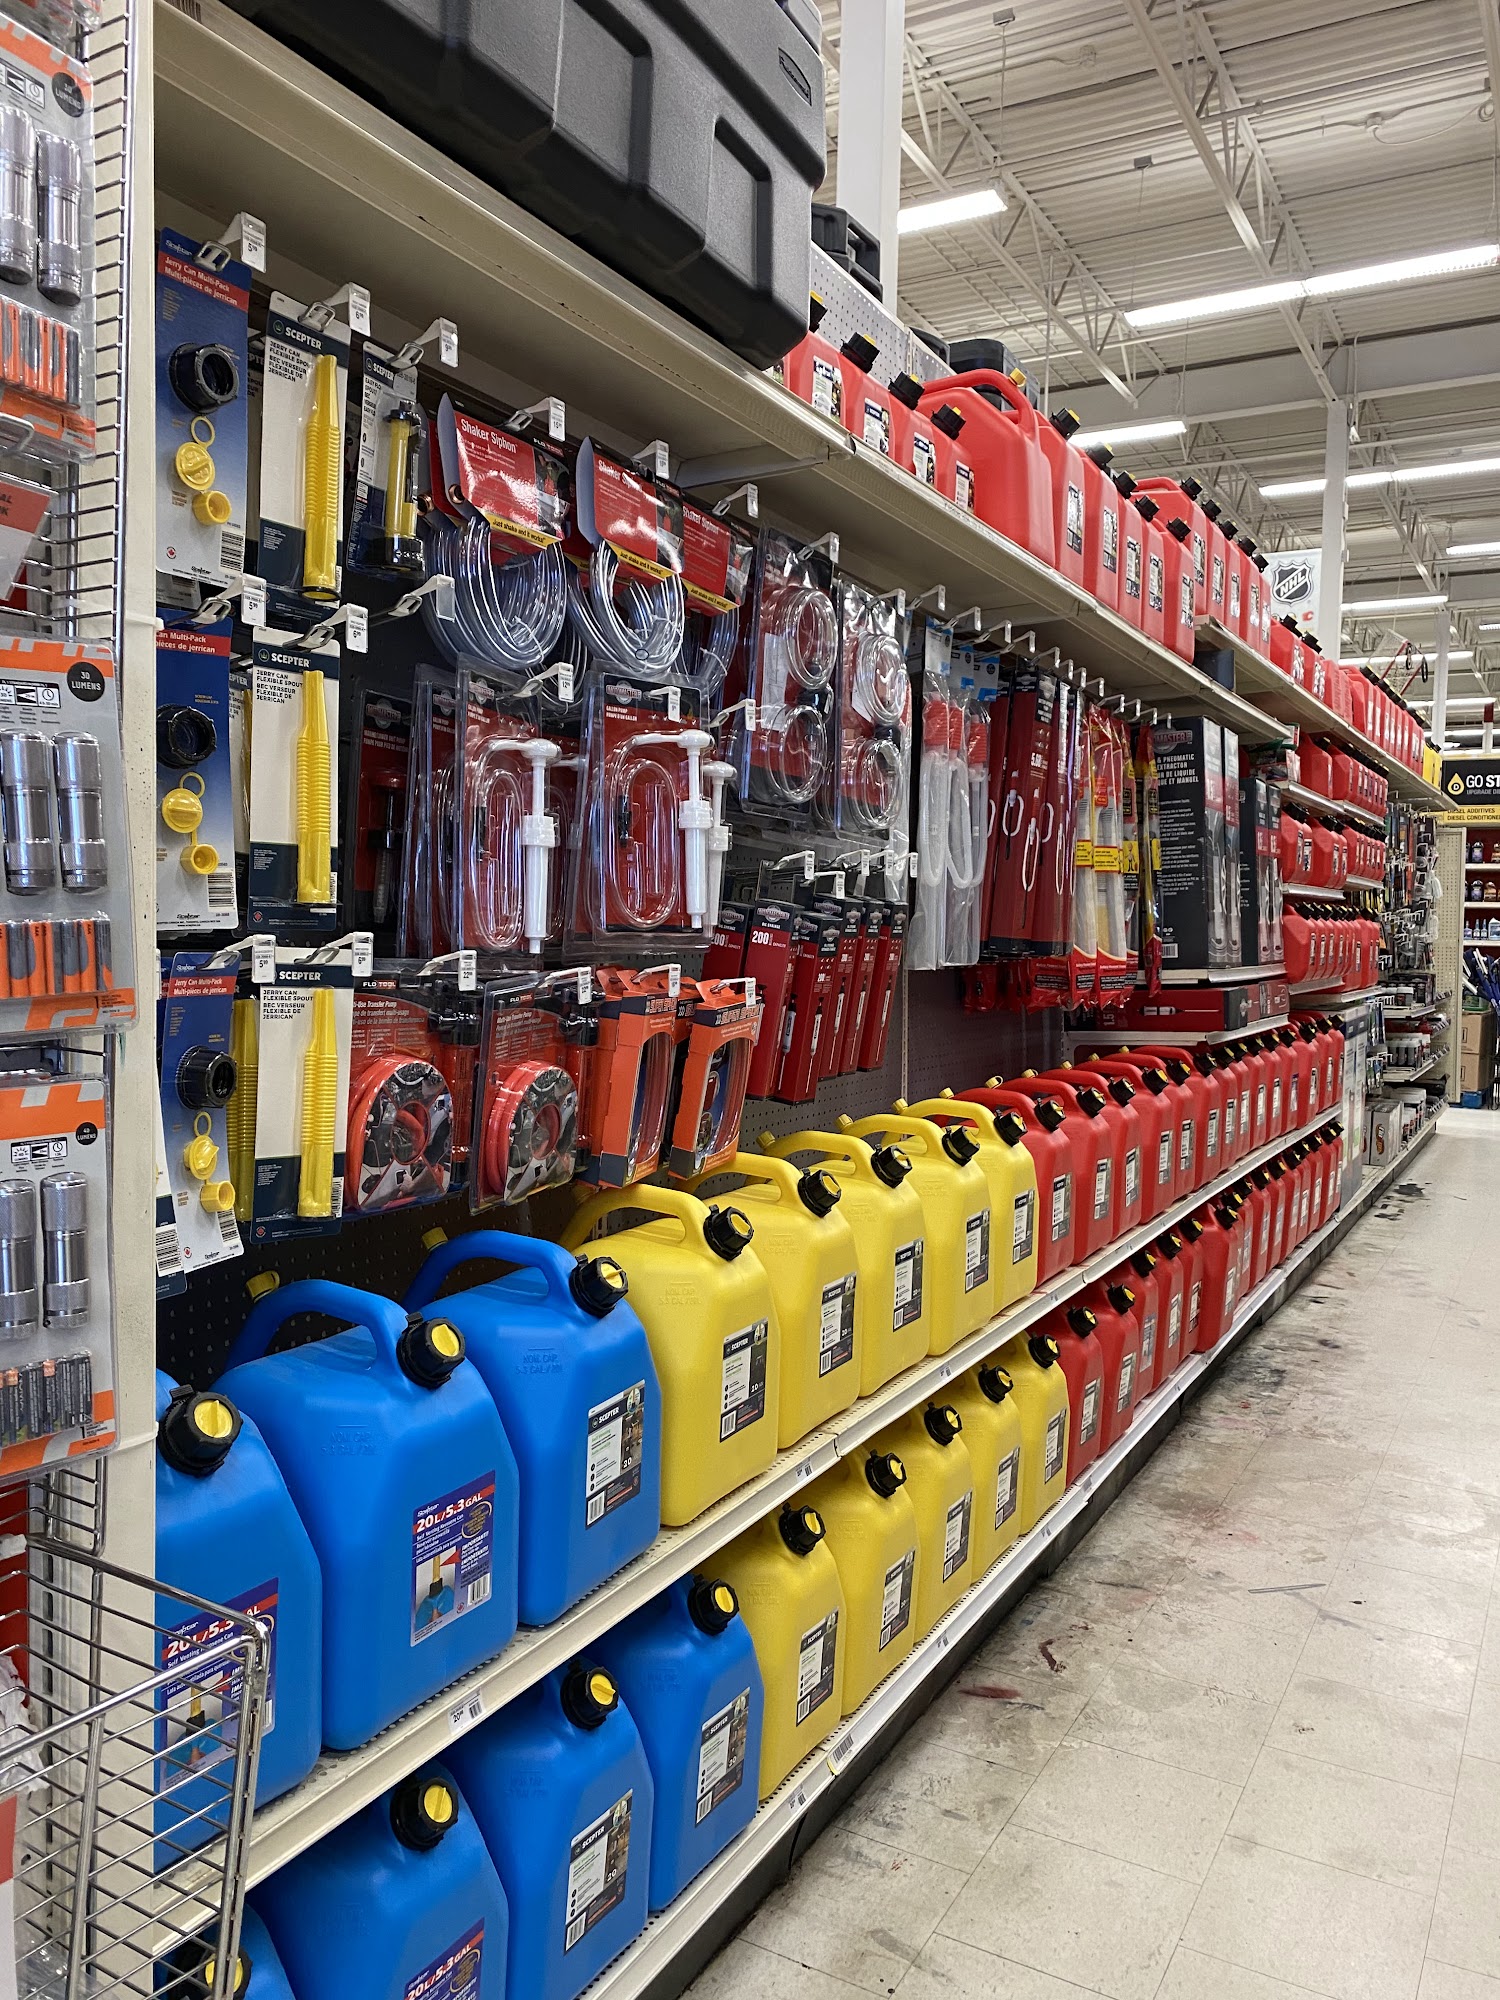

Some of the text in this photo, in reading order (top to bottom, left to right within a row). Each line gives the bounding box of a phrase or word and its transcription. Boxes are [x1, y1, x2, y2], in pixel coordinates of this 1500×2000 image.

[165, 257, 230, 292] Jerry Can Multi-Pack
[164, 267, 238, 306] Multi-pièces de jerrican
[285, 326, 322, 350] SCEPTER
[270, 341, 300, 358] JERRY CAN
[269, 355, 306, 374] BEC VERSEUR
[270, 348, 314, 368] FLEXIBLE SPOU
[268, 367, 296, 382] JERRICAN
[269, 361, 303, 380] FLEXIBLE DE
[373, 362, 394, 381] SCEPTER
[461, 419, 489, 441] Shaker
[493, 519, 502, 528] Just
[504, 522, 518, 534] shake
[518, 528, 526, 536] and
[1279, 568, 1307, 598] NHL
[170, 632, 206, 643] Multi-Pack
[178, 642, 215, 654] de jerrican
[271, 653, 310, 668] SCEPTER
[81, 672, 90, 680] 30
[256, 669, 275, 678] JERRY
[71, 682, 101, 690] LUMENS
[256, 676, 303, 688] FLEXIBLE SPOUT
[269, 684, 296, 694] VERSEUR
[256, 689, 283, 699] FLEXIBLE
[256, 694, 285, 704] JERRICAN
[1163, 754, 1194, 762] PNEUMATIC
[1174, 769, 1195, 777] LIQUIDE
[1466, 774, 1483, 788] GO
[752, 930, 769, 945] 200
[175, 978, 187, 987] Jerry
[279, 971, 320, 980] SCEPTER
[174, 987, 201, 995] Multi-pièces
[598, 1406, 619, 1424] SCEPTER
[465, 1493, 483, 1507] GAL
[426, 1526, 440, 1536] Venting
[246, 1606, 260, 1617] AL
[168, 1632, 234, 1668] Self Venting Can
[167, 1668, 214, 1695] Lata para
[710, 1716, 728, 1734] SCEPTER
[582, 1825, 605, 1849] SCEPTER
[606, 1868, 617, 1882] 20
[454, 1944, 472, 1962] GAL
